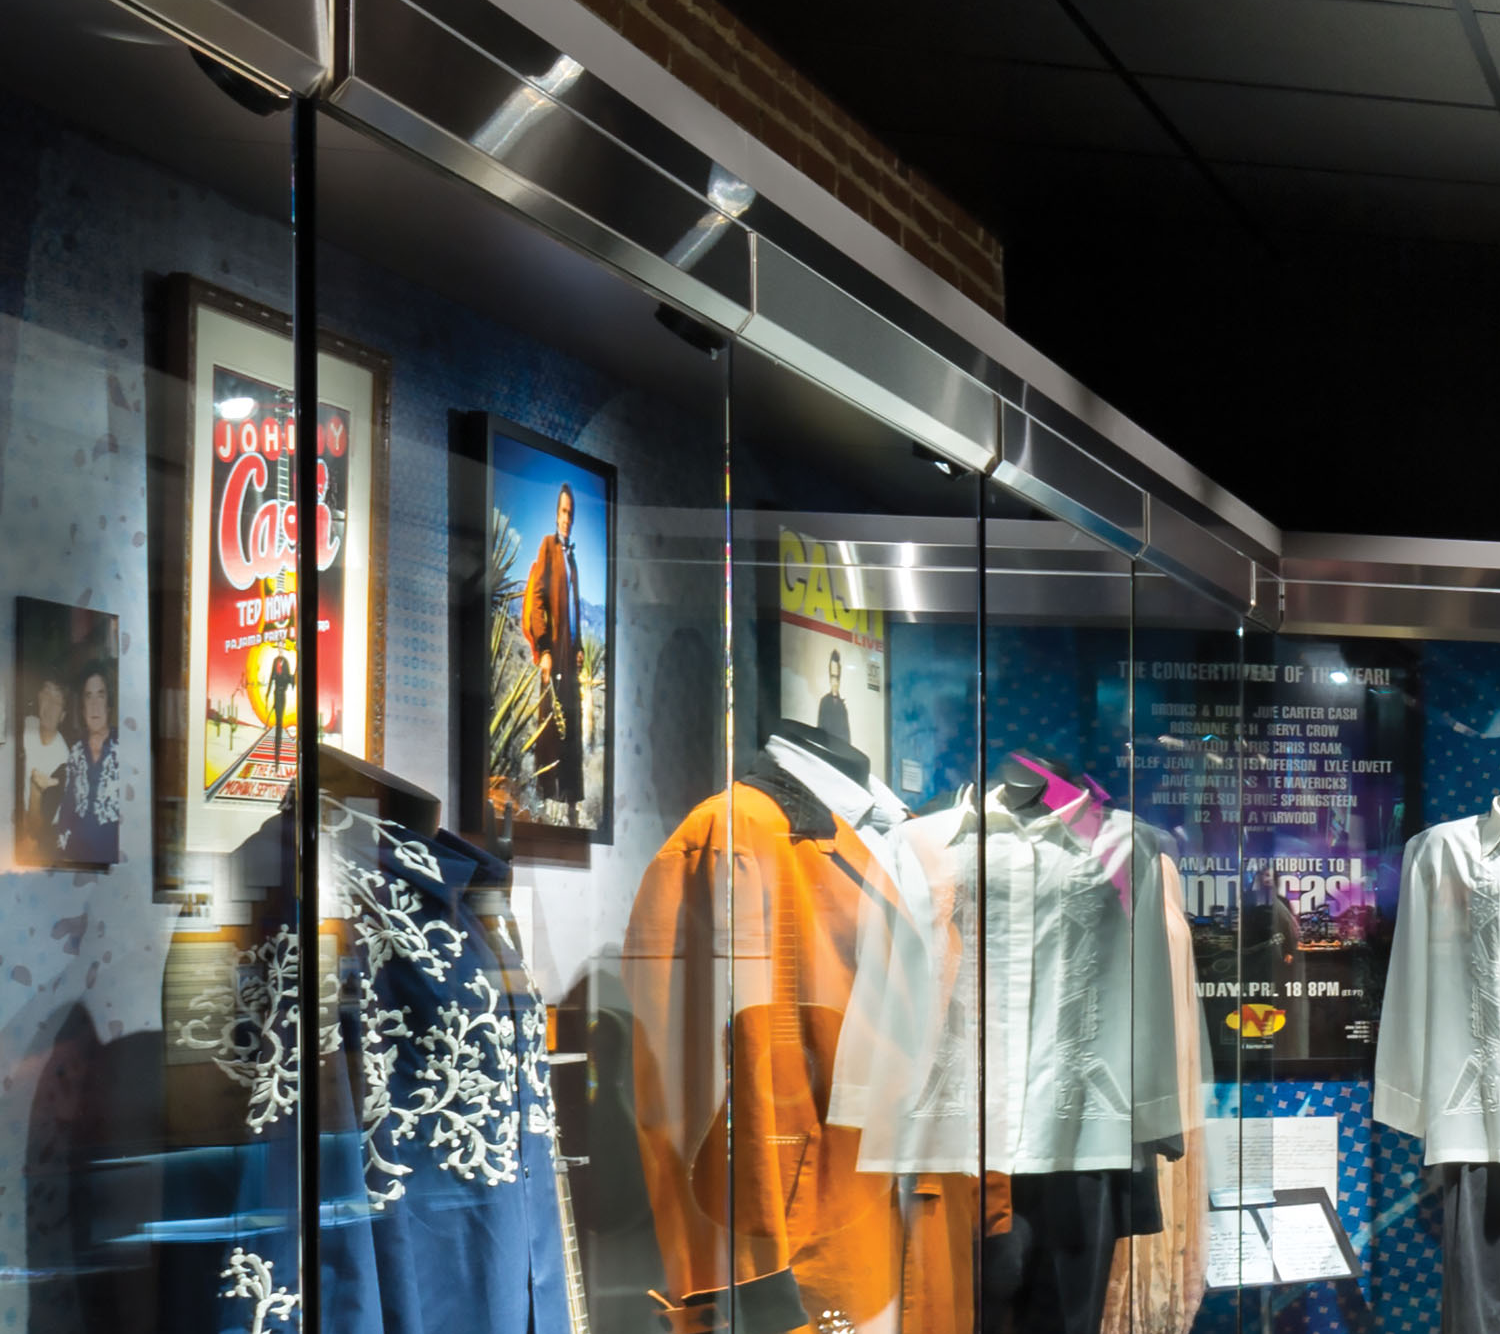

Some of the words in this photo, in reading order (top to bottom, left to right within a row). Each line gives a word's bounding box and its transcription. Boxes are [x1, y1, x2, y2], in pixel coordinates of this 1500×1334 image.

[236, 599, 262, 627] TED
[853, 634, 883, 651] LIVE
[1284, 665, 1304, 684] OF
[1282, 706, 1325, 720] CARTER
[1327, 707, 1358, 720] CASH
[1306, 724, 1340, 737] CROW
[1273, 740, 1306, 755] CHRIS
[1308, 742, 1343, 755] ISAAK
[1164, 757, 1195, 770] JEAN
[1324, 760, 1349, 773] LYLE
[1352, 760, 1393, 774] LOVETT
[1161, 775, 1190, 787] DAVE
[1284, 776, 1348, 790] MAVERICKS
[1151, 792, 1190, 805] WILLIE
[1281, 794, 1358, 807] SPRINGSTEEN
[1194, 810, 1211, 823] U2
[1206, 857, 1232, 872] ALL
[1328, 858, 1346, 873] TO
[1277, 858, 1377, 917] cash
[1285, 982, 1303, 997] 18
[1307, 981, 1340, 997] 8PM
